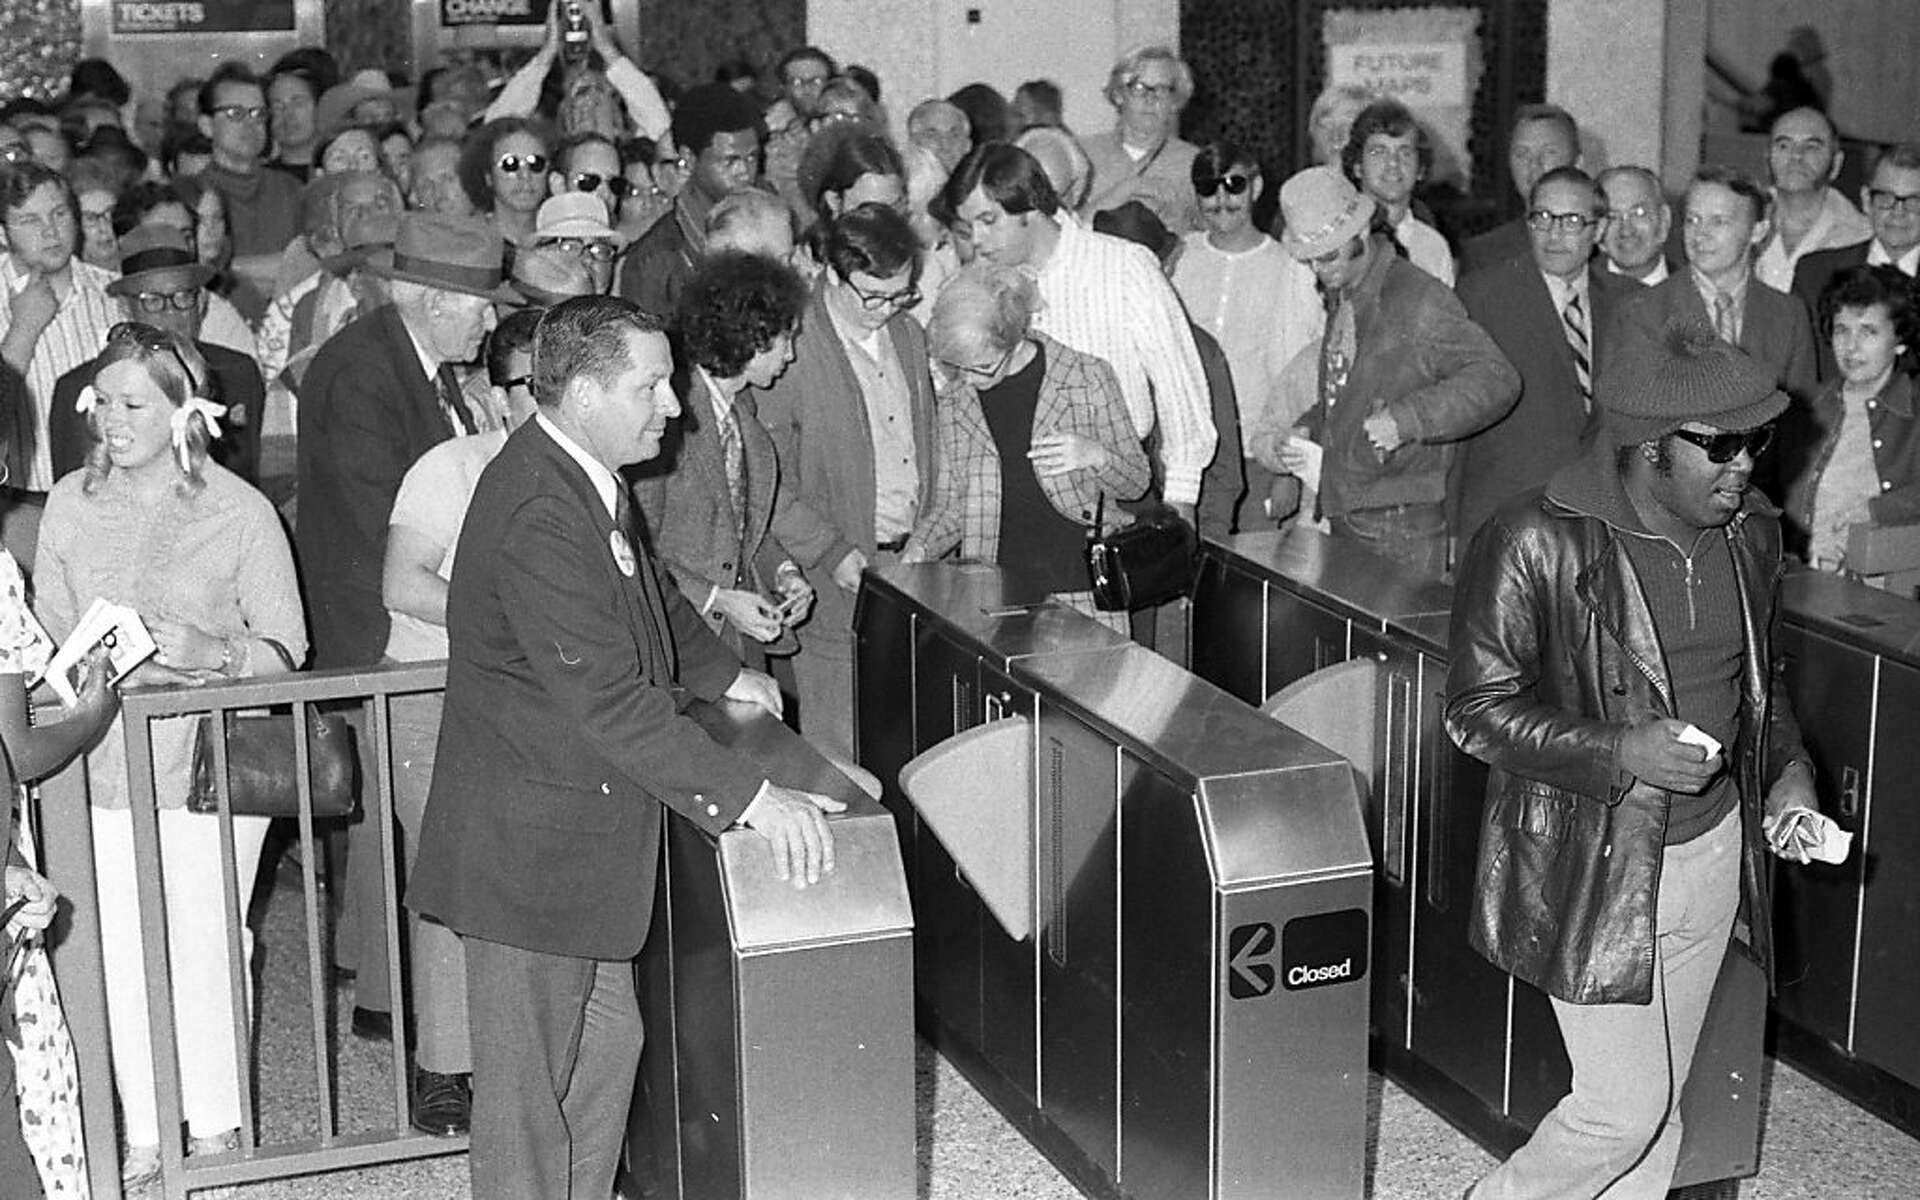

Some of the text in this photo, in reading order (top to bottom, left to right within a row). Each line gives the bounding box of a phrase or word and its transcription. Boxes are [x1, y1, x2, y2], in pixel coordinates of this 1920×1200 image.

[119, 3, 204, 22] TICKETS
[446, 0, 531, 16] CHANGE
[1353, 52, 1444, 71] FUTURE
[1288, 957, 1351, 985] Closed
